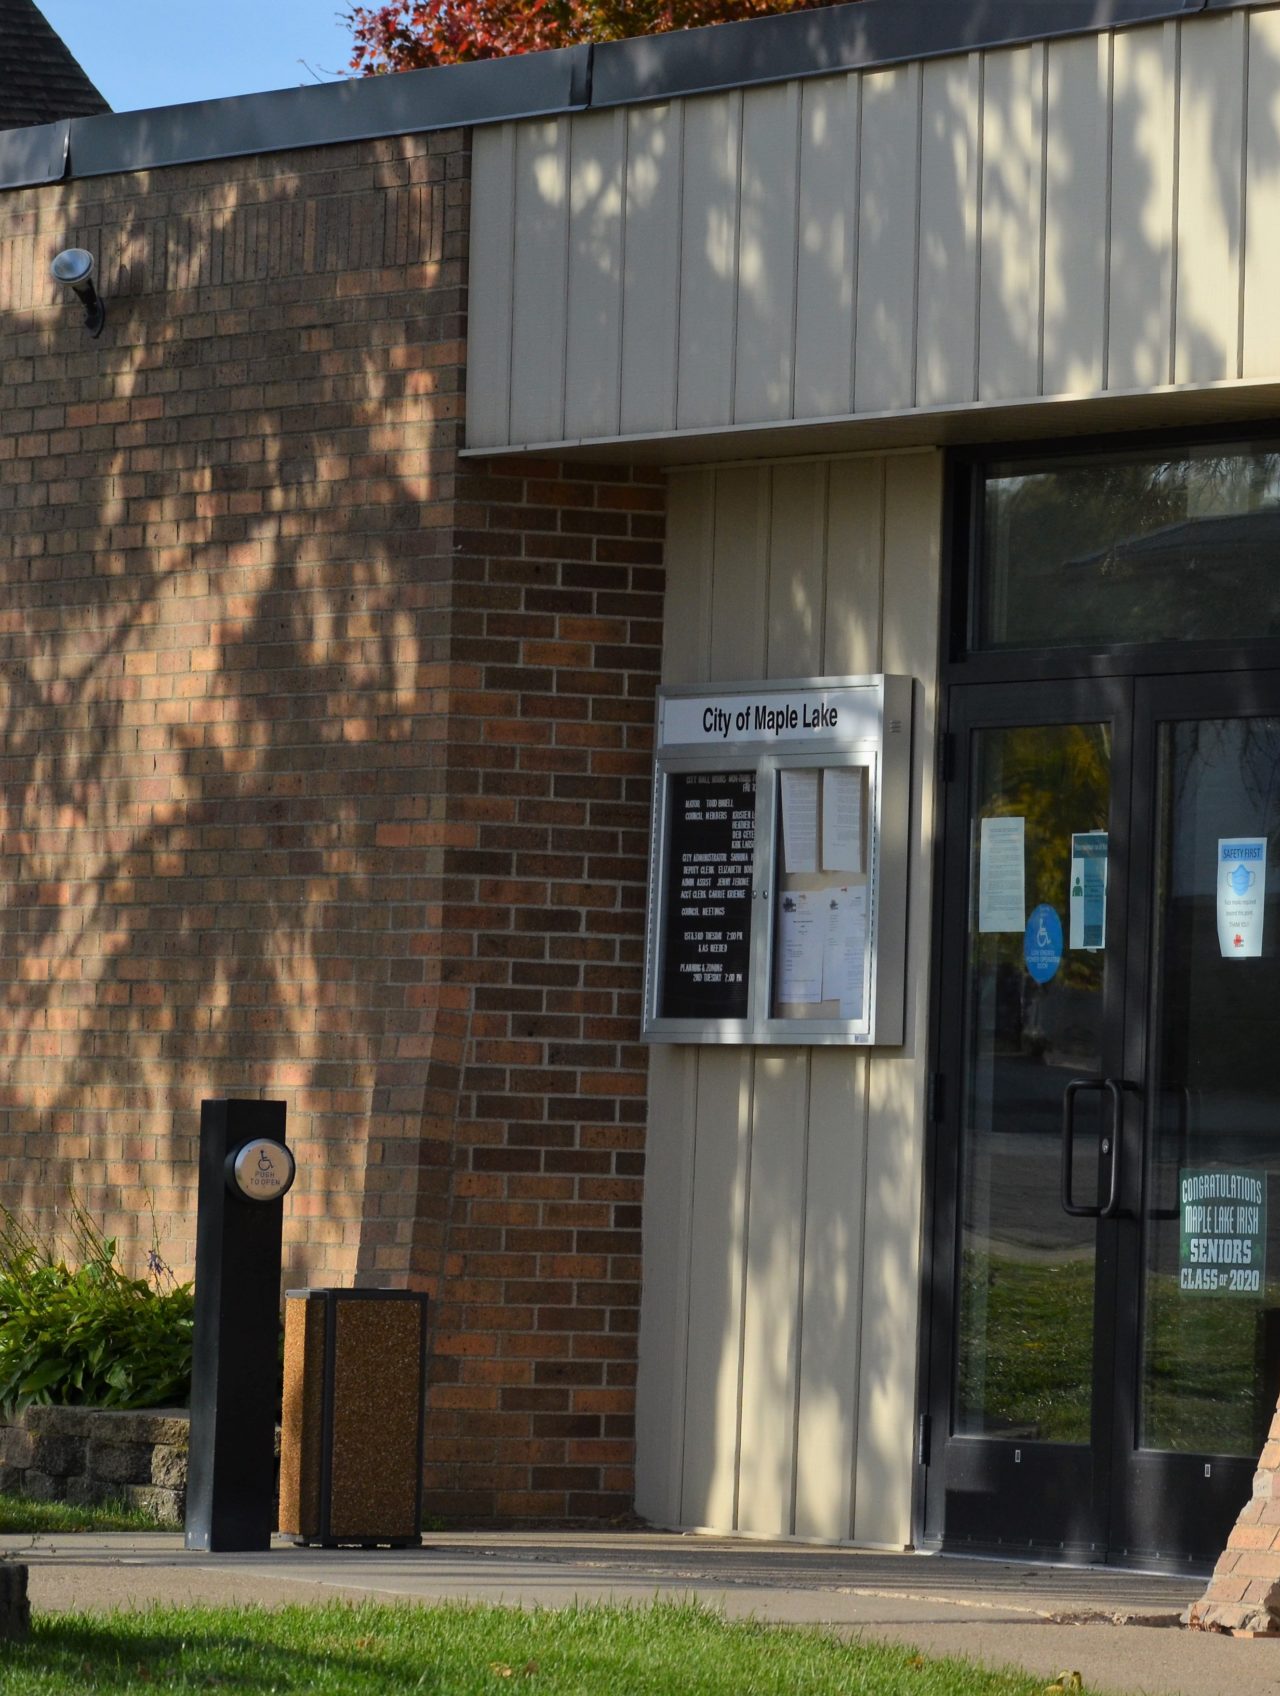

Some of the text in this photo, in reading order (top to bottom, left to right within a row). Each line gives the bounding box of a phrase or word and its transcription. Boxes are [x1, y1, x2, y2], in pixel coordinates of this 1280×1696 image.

[702, 702, 838, 738] City of Maple Lake
[1223, 847, 1261, 859] SAFETY FIRST
[260, 1178, 281, 1186] OPEN
[1182, 1174, 1262, 1204] CONGRATULATIONS
[1185, 1205, 1259, 1235] MAPLE LAKE IRISH
[1190, 1238, 1252, 1264] SENIORS
[1180, 1268, 1219, 1290] CLASS
[1228, 1269, 1260, 1291] 2020
